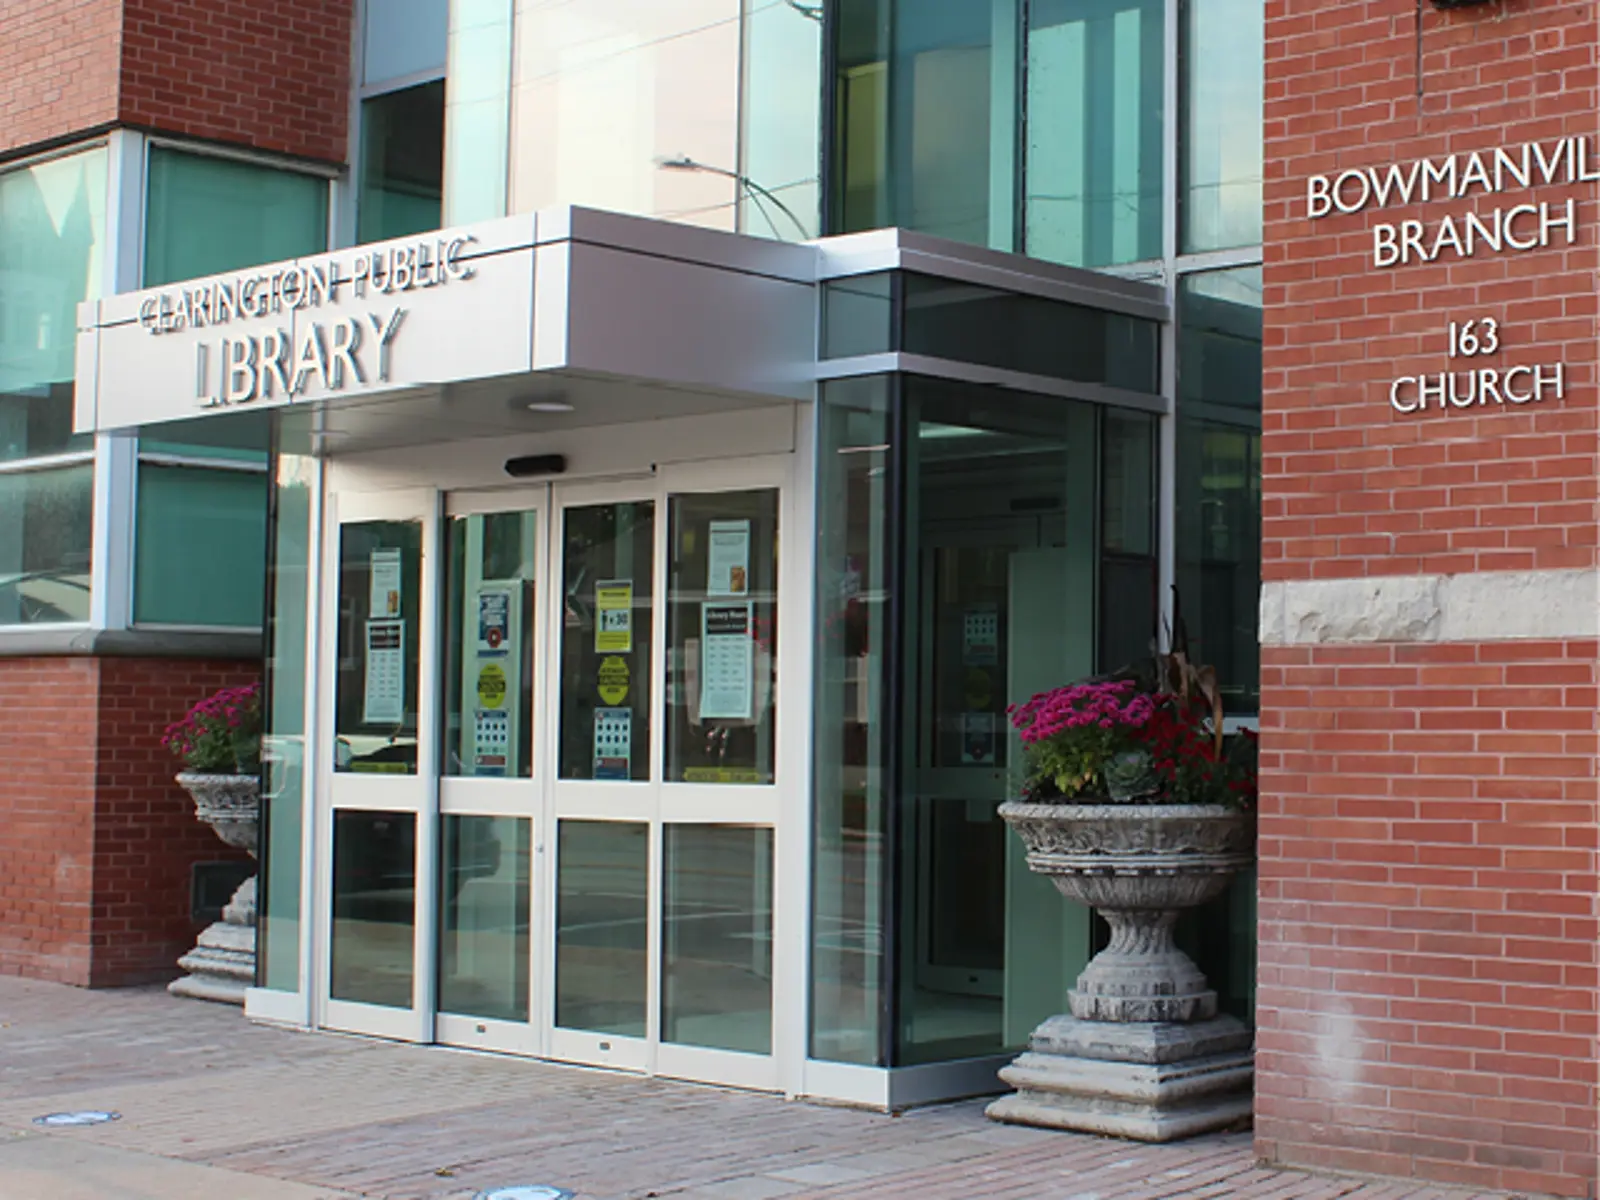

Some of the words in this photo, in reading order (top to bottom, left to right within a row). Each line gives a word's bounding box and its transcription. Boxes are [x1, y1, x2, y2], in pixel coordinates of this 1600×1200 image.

[1307, 136, 1600, 219] BOWMANVIL
[1373, 198, 1576, 267] BRANCH
[137, 262, 341, 336] CLARINGTON
[352, 233, 480, 298] PUBLIC
[194, 305, 409, 408] LIBRARY
[1449, 317, 1499, 358] 163
[1390, 362, 1565, 413] CHURCH
